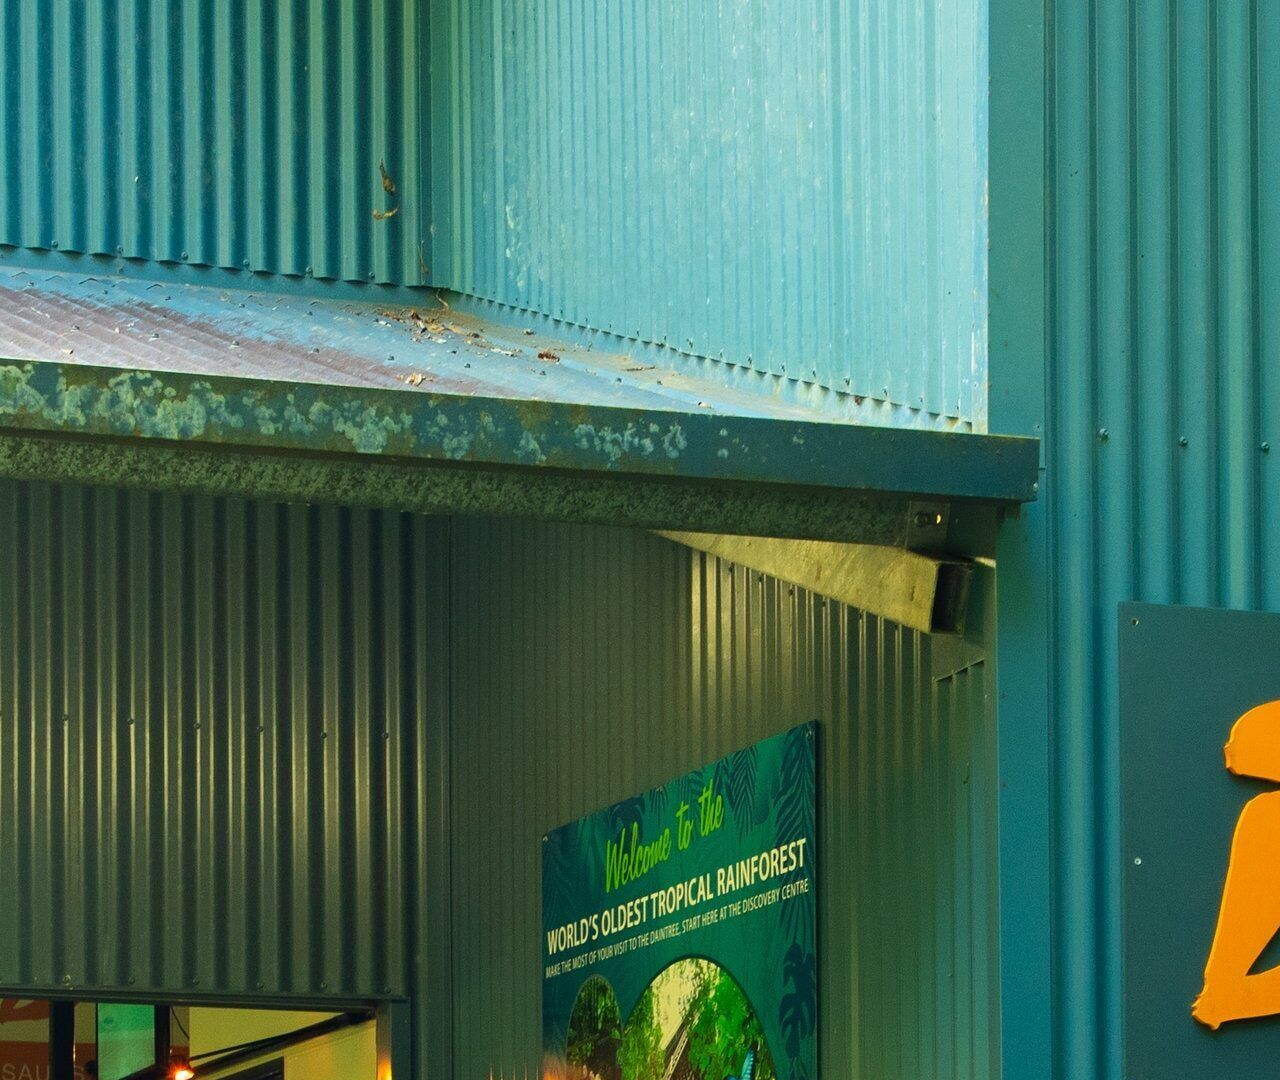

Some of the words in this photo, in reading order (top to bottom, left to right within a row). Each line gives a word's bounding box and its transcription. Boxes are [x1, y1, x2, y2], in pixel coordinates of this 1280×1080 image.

[605, 821, 672, 894] Welcome
[676, 801, 694, 851] to
[698, 779, 724, 837] the
[545, 961, 561, 979] MAKE
[561, 957, 572, 974] THE
[572, 953, 588, 972] MOST
[588, 949, 598, 966] OF
[597, 943, 614, 963] YOUR
[613, 939, 628, 957] VISIT
[628, 935, 638, 952] TO
[637, 931, 650, 949] THE
[682, 914, 701, 934] START
[702, 908, 718, 928] HERE
[719, 904, 728, 920] AT
[728, 899, 742, 917] THE
[742, 886, 781, 914] DISCOVERY
[781, 878, 809, 900] CENTRE
[547, 914, 600, 955] WORLD'S
[601, 896, 649, 938] OLDEST
[650, 873, 714, 919] TROPICAL
[717, 837, 807, 896] RAINFOREST
